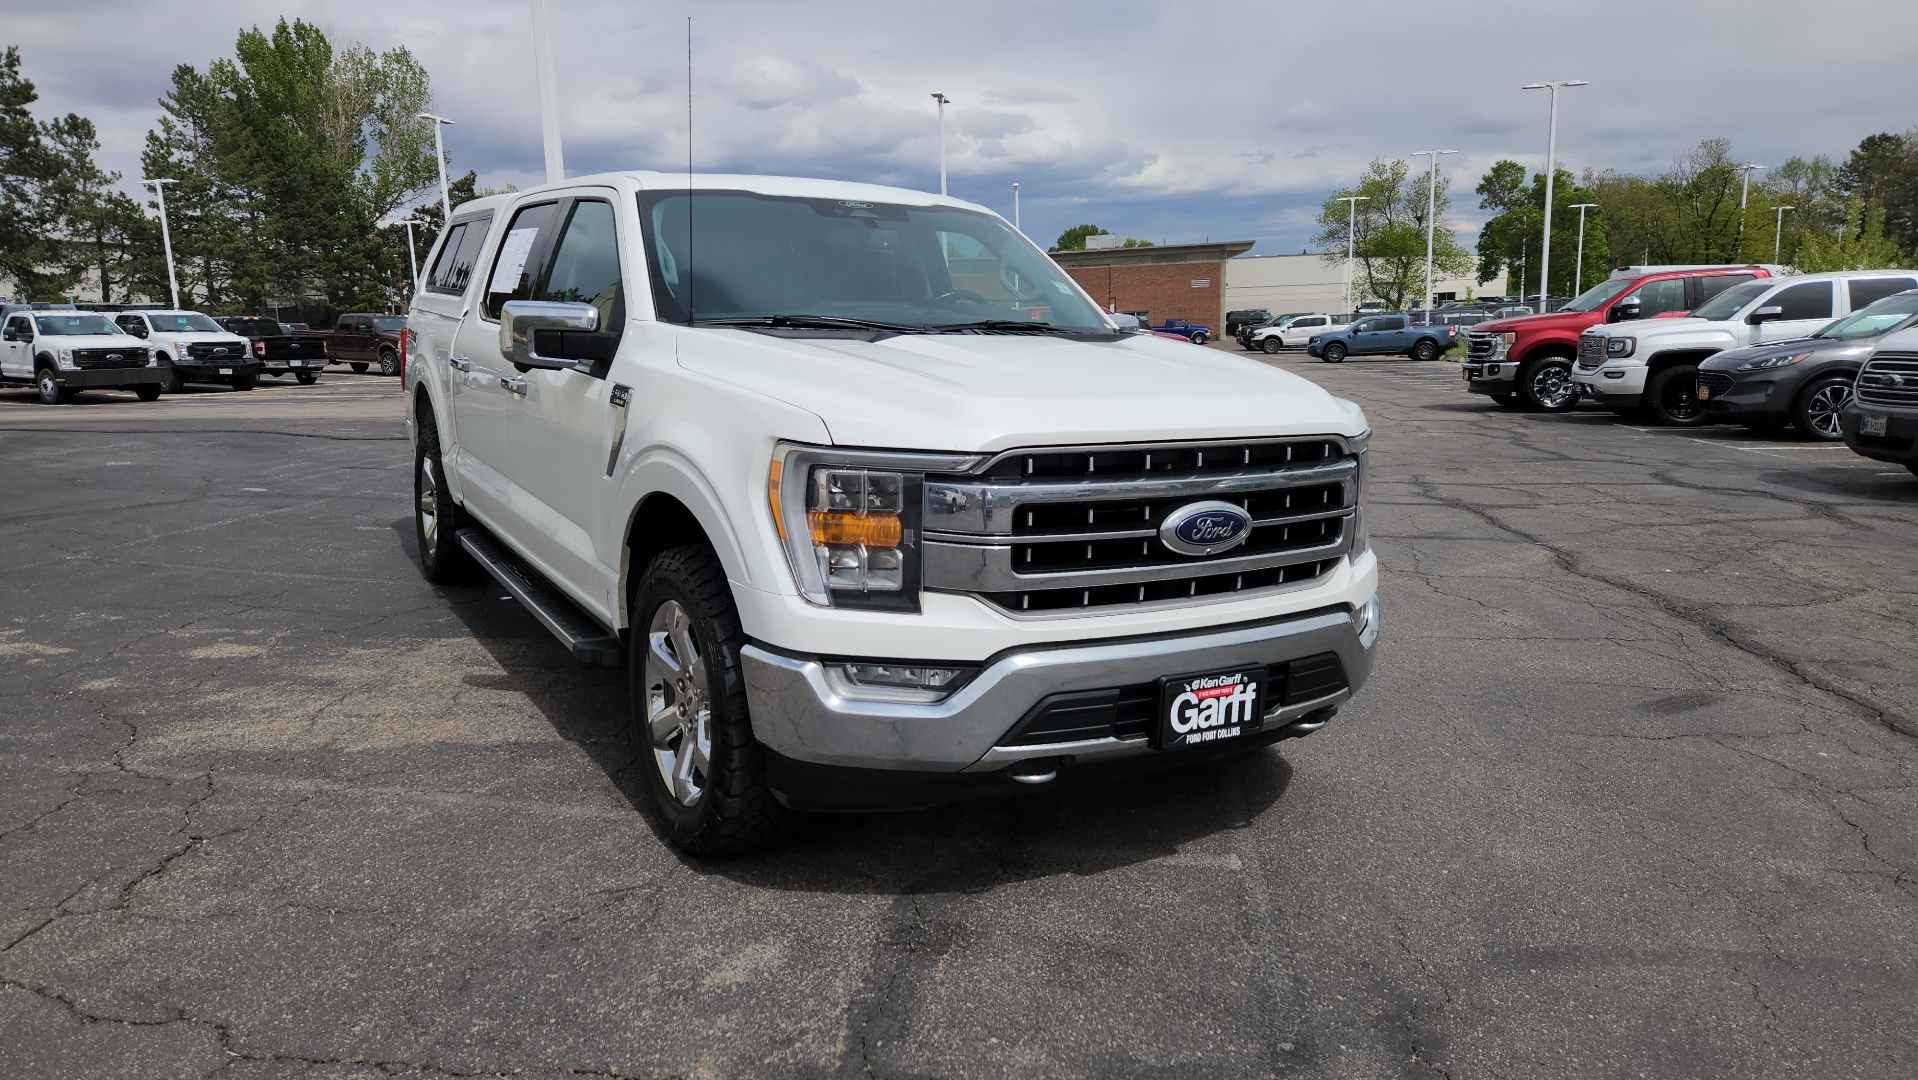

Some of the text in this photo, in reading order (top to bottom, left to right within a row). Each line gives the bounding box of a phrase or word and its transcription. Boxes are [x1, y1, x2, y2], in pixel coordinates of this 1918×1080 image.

[1191, 516, 1235, 540] Ford
[1199, 677, 1219, 689] Ken
[1218, 673, 1242, 686] Garff
[1170, 682, 1257, 733] Garff
[1186, 726, 1241, 744] FORD FORT COLLINS
